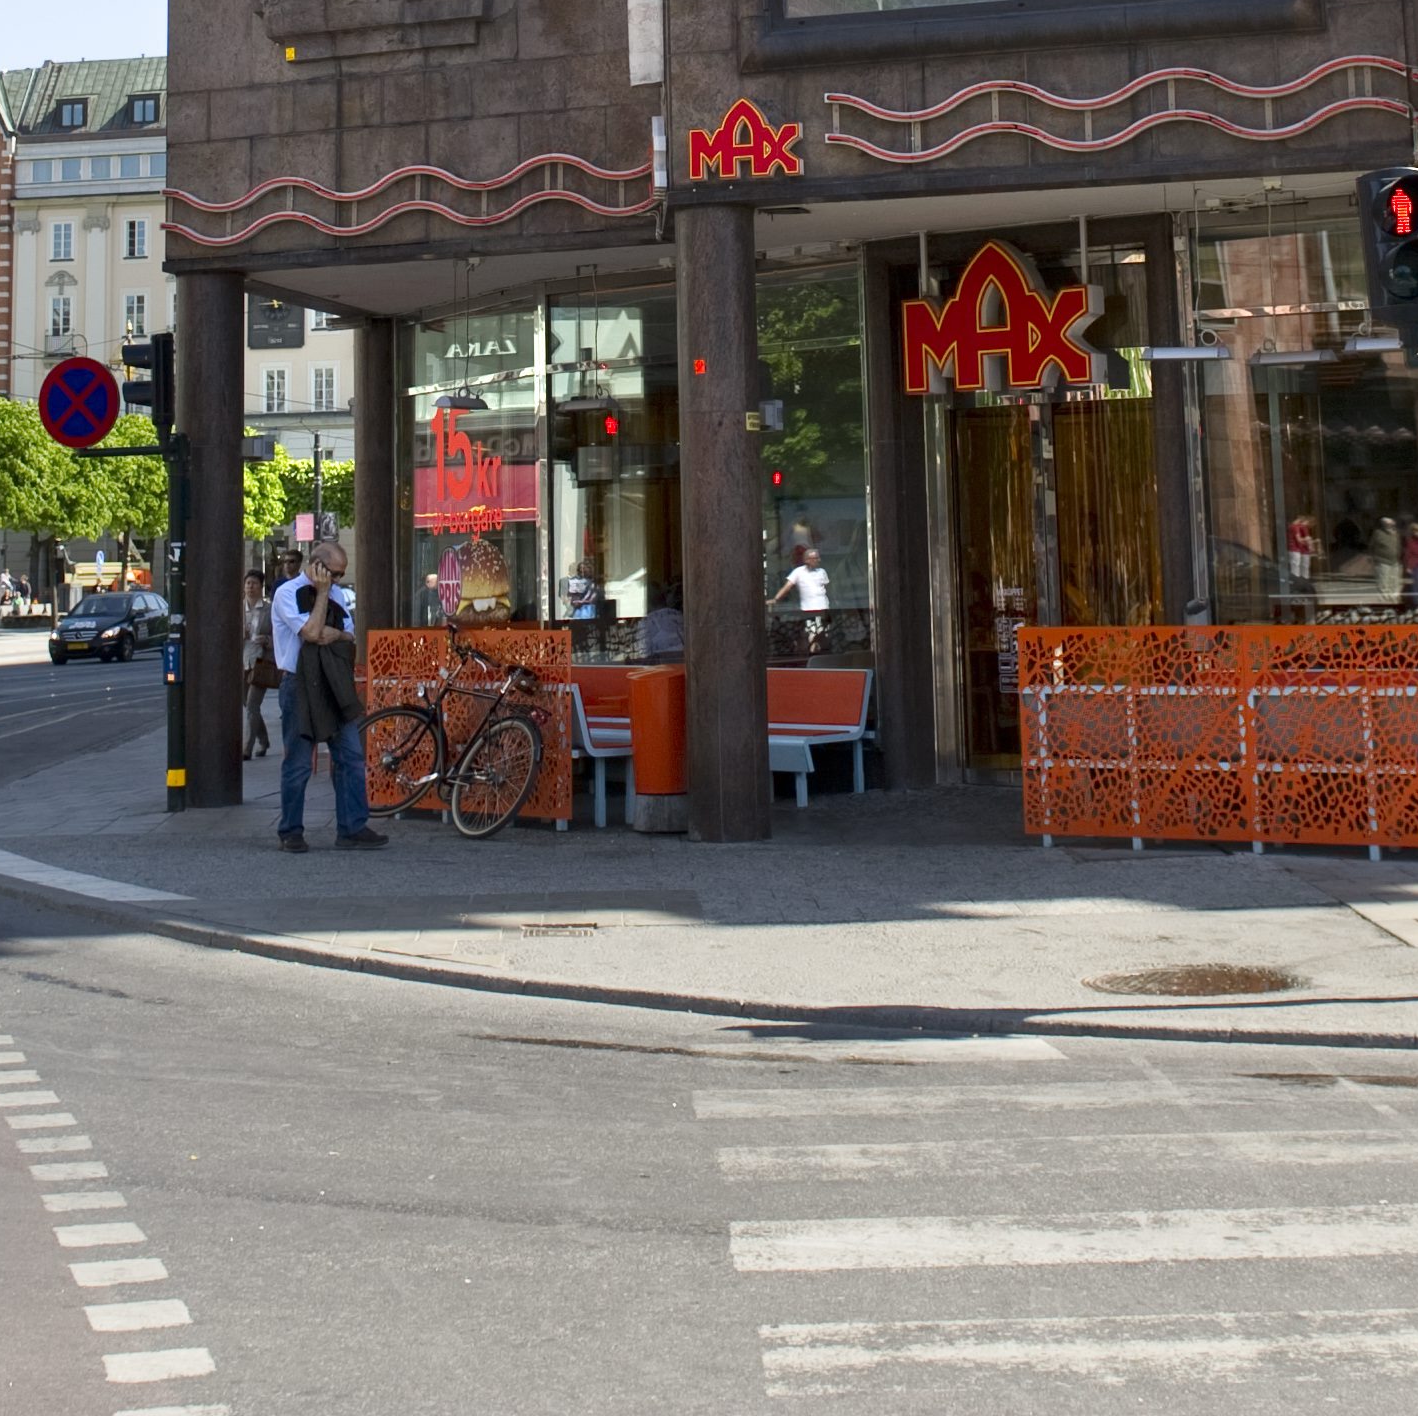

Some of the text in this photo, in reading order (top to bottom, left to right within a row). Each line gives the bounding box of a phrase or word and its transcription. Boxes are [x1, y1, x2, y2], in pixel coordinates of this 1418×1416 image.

[687, 96, 802, 182] MAX
[901, 239, 1093, 395] MAX
[430, 407, 502, 503] 15 kr
[438, 582, 461, 614] PRIS
